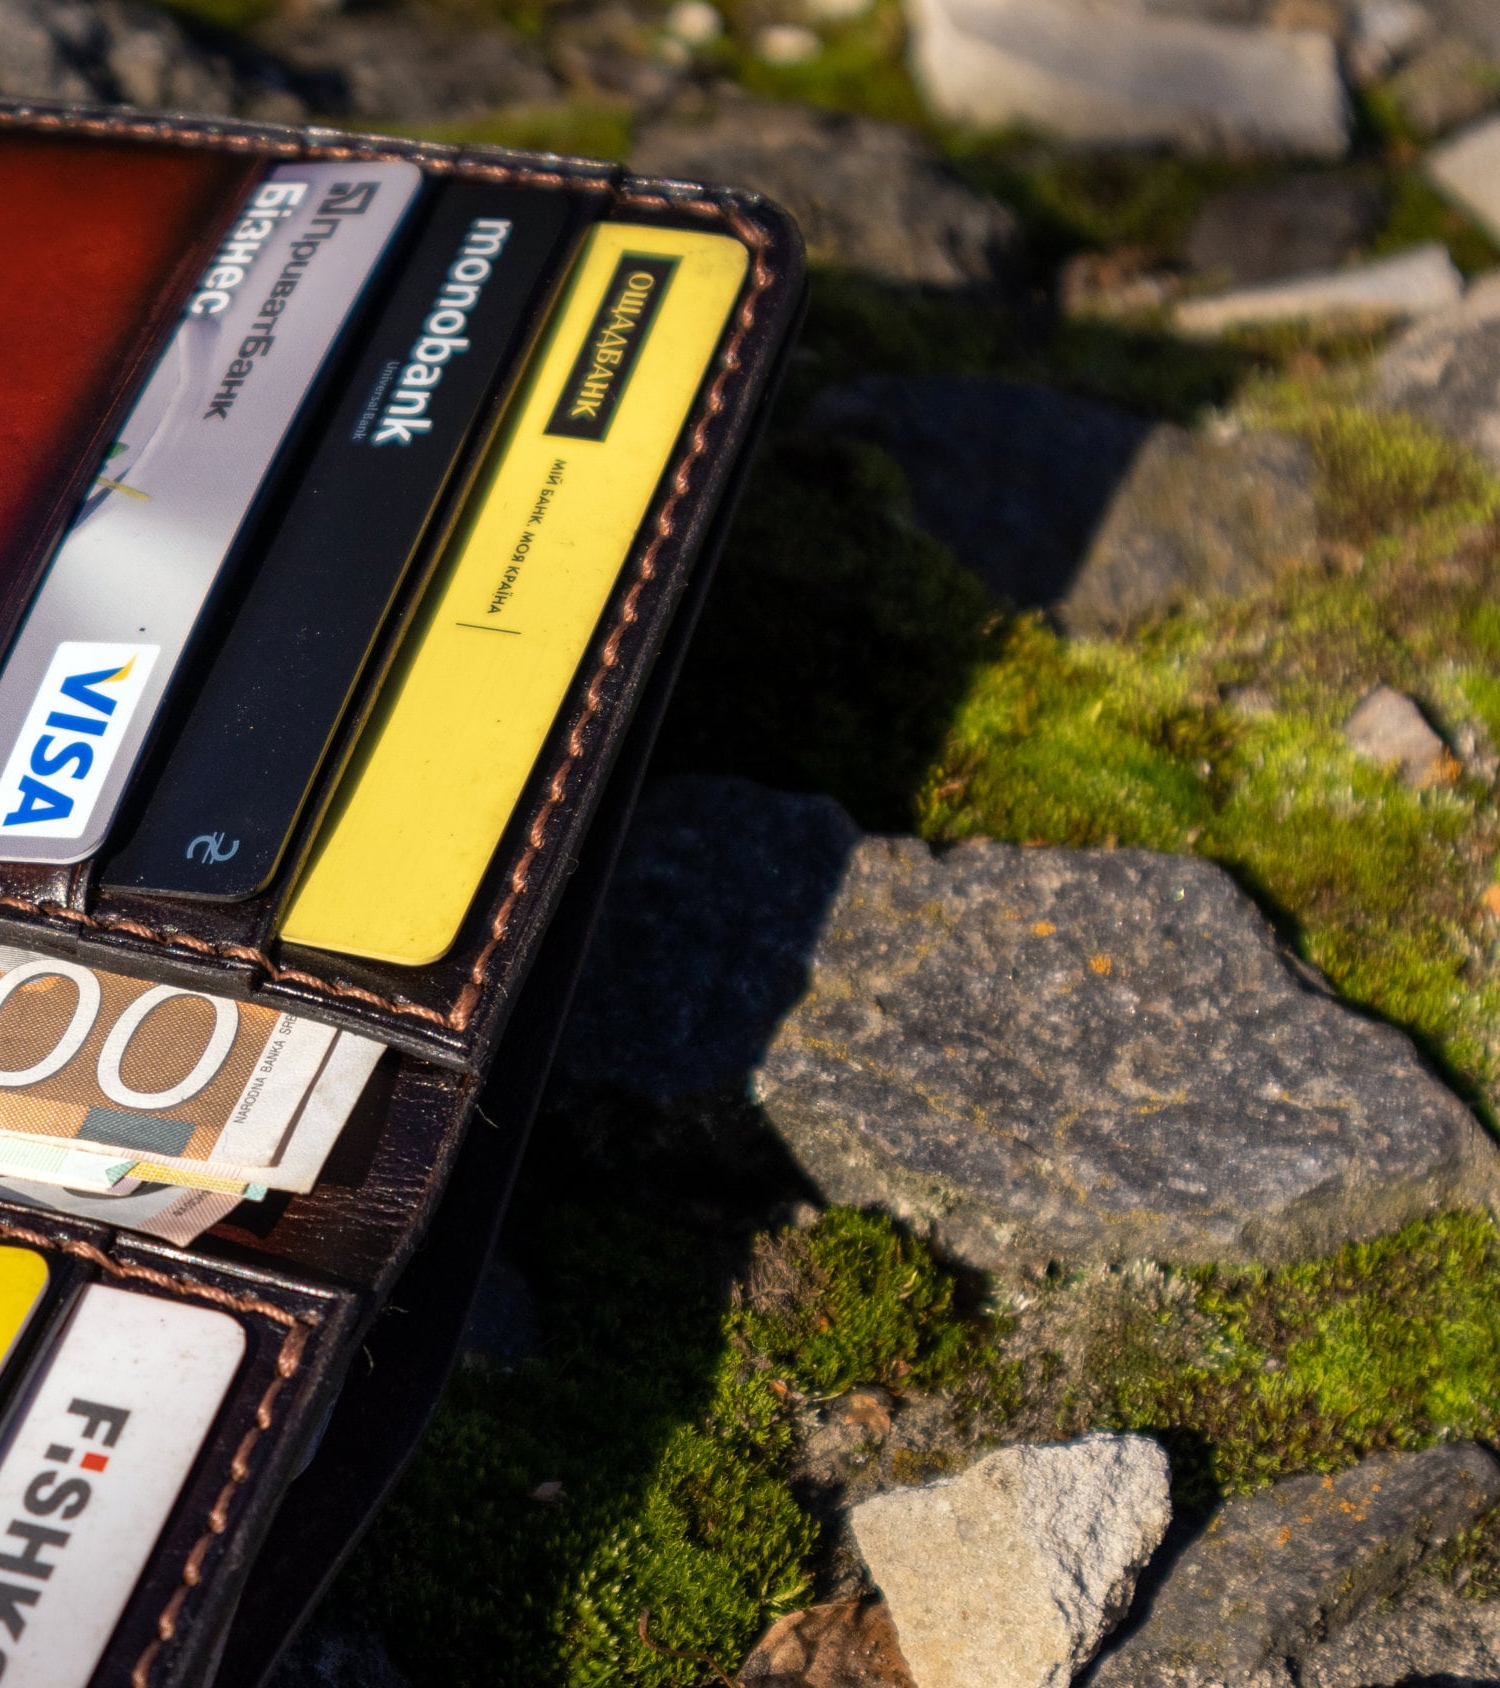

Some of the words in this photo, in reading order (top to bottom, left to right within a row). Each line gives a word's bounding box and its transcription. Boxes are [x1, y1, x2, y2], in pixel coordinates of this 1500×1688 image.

[189, 181, 308, 315] Бізнес
[204, 215, 343, 421] ПриватБанк
[373, 218, 512, 444] monobank
[570, 271, 655, 420] ОЩАДБАНК
[352, 413, 375, 440] Bank
[366, 361, 400, 412] Universal
[545, 459, 566, 485] МІЙ
[511, 531, 535, 562] МОЯ
[487, 565, 520, 614] КРАЇНА
[2, 652, 139, 827] VISA
[233, 1076, 267, 1124] NARODNA
[260, 1039, 286, 1073] BANKA
